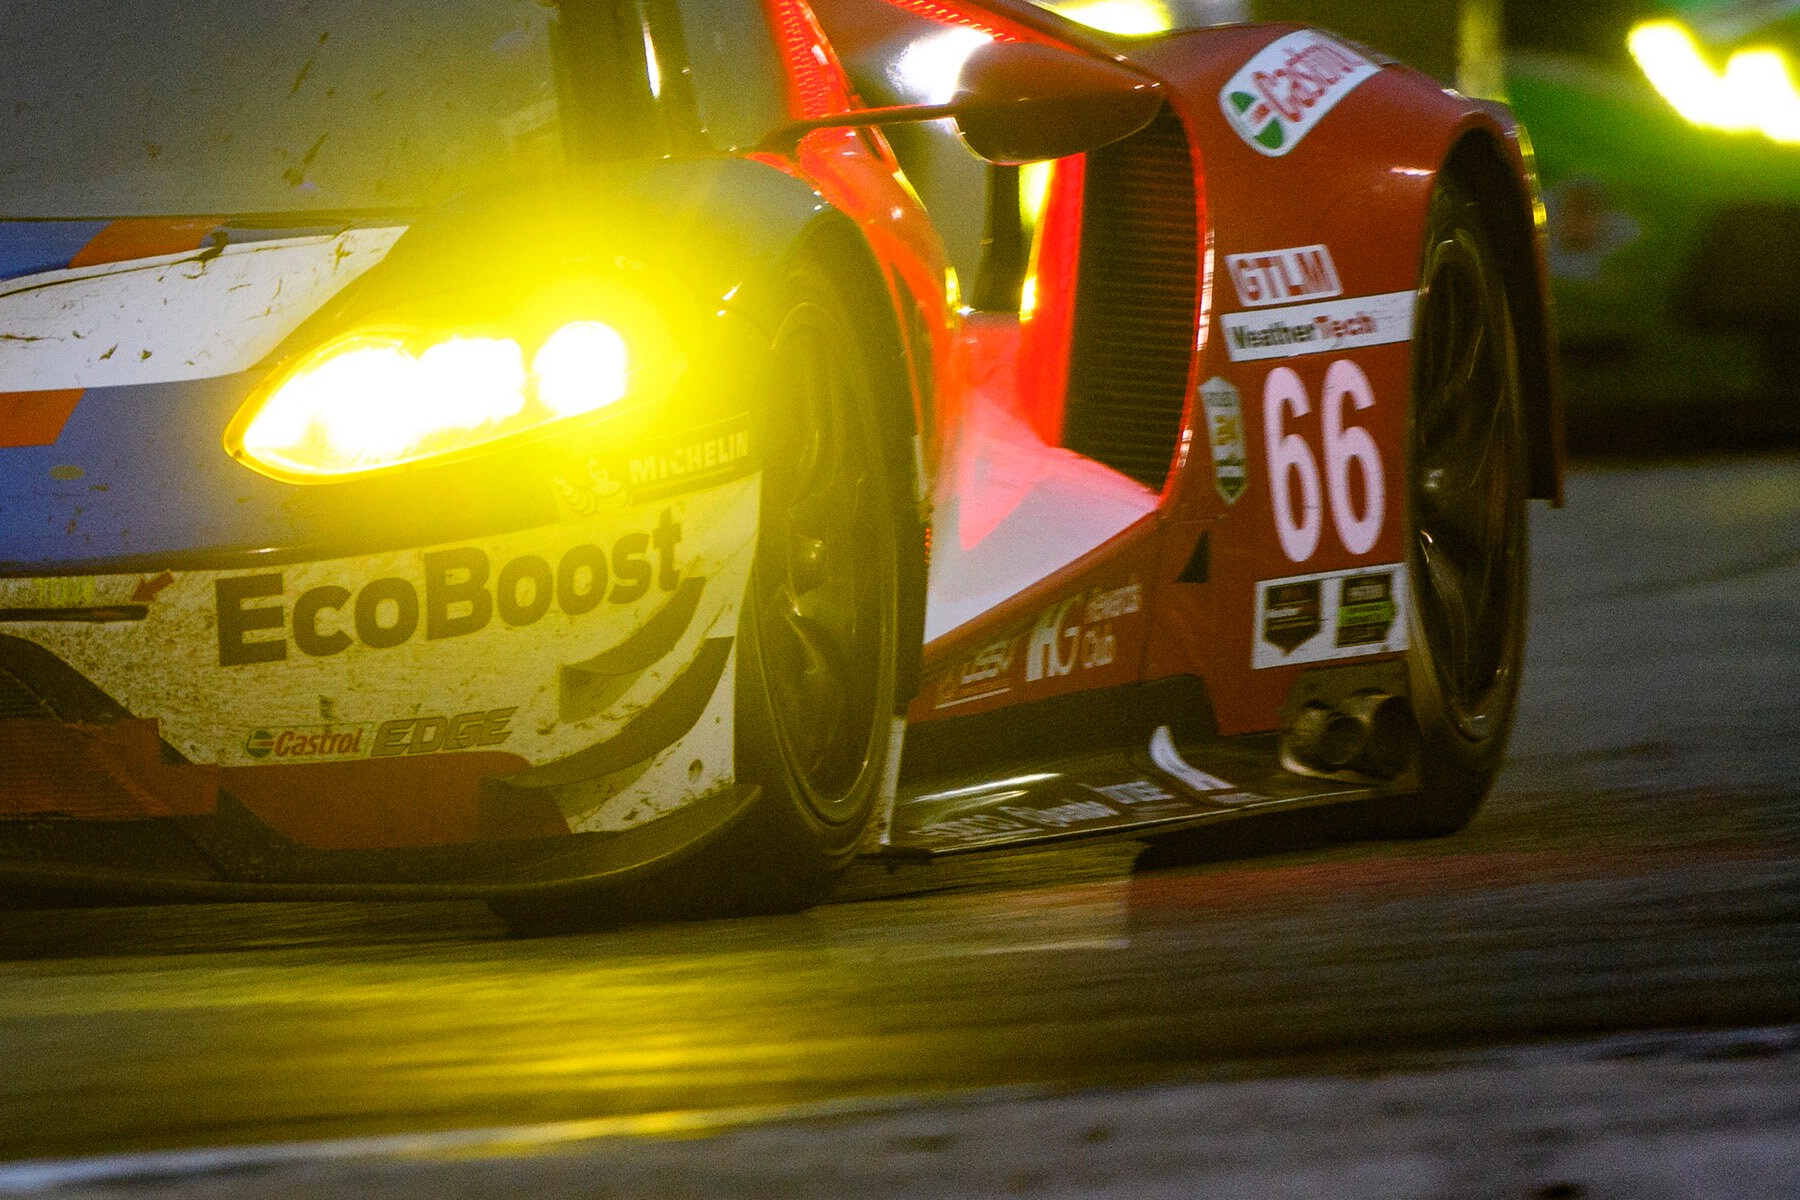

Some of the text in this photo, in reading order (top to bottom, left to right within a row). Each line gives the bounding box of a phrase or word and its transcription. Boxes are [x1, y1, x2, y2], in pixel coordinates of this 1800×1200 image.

[1235, 250, 1335, 301] GTLM
[1231, 311, 1378, 350] WeatherTech
[627, 430, 749, 484] MICHELIN
[1263, 358, 1386, 563] 66
[214, 506, 682, 668] EcoBoost
[273, 705, 520, 757] Castrol EDGE
